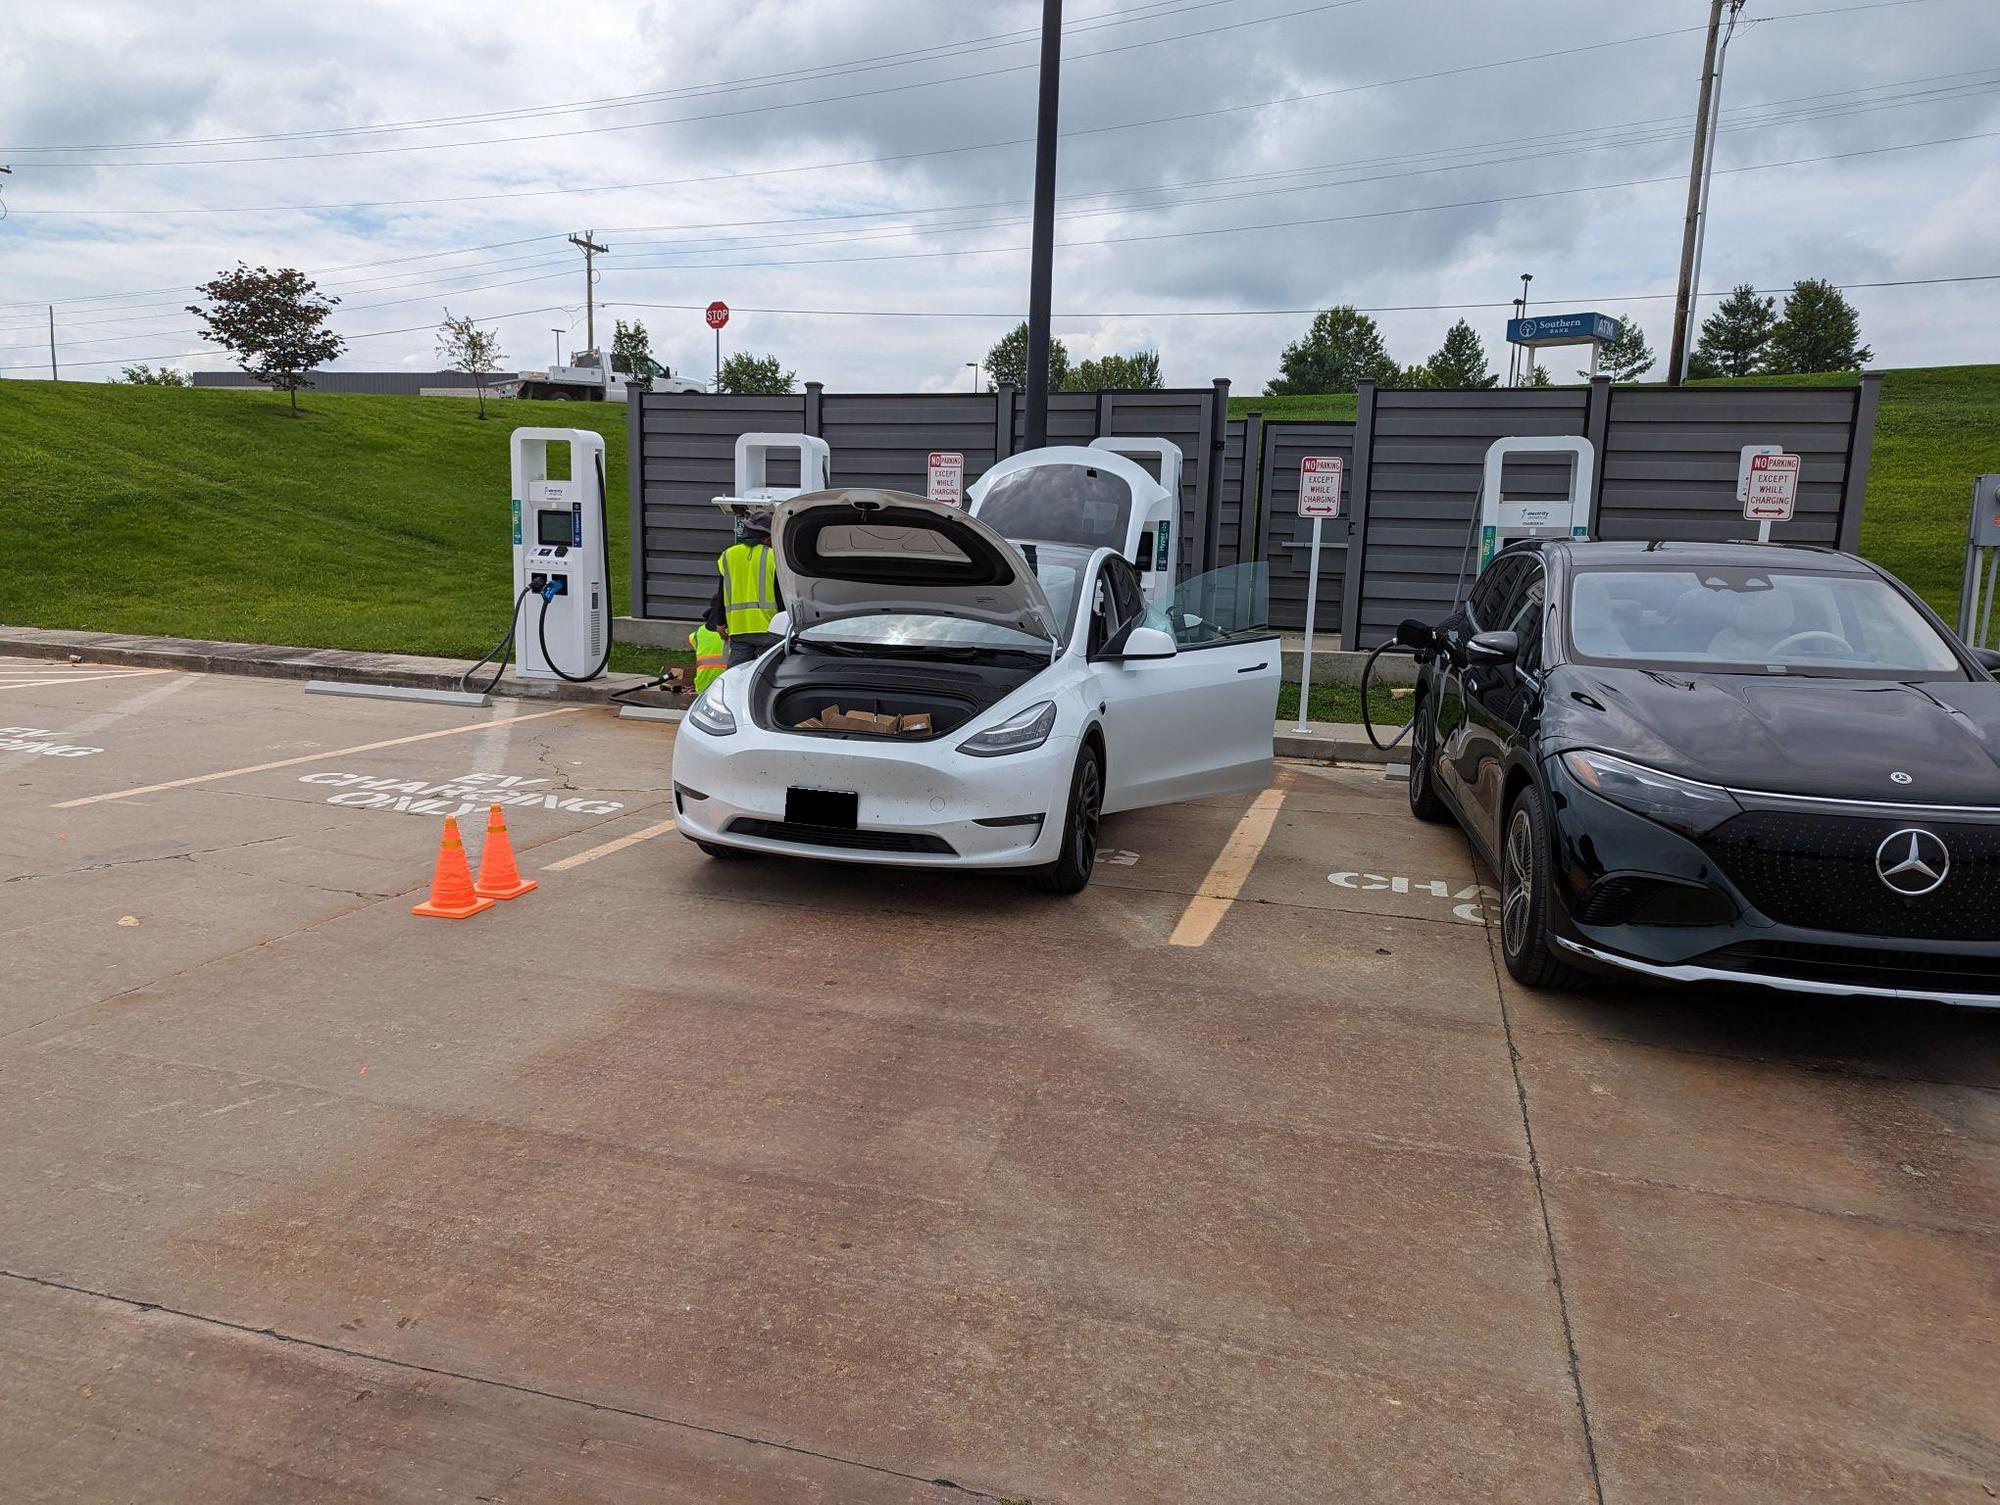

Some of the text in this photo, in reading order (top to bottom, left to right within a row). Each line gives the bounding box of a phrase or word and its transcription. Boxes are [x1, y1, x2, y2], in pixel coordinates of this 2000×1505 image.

[707, 310, 728, 321] STOP
[1539, 319, 1581, 329] Southern
[1597, 318, 1614, 336] ATM
[931, 455, 961, 465] NO PARKING
[1305, 460, 1340, 470] NO PARKING
[1755, 457, 1797, 469] NO PARKING
[934, 470, 957, 478] EXCEPT
[1758, 474, 1789, 483] EXCEPT
[936, 479, 955, 487] WHILE
[1308, 476, 1335, 484] EXCEPT
[1310, 486, 1331, 494] WHILE
[1759, 485, 1784, 494] WHILE
[1303, 495, 1336, 504] CHARGING
[1750, 496, 1790, 505] CHARGING
[449, 773, 550, 787] EV
[298, 772, 625, 815] CHARGING
[326, 792, 493, 817] ONLY
